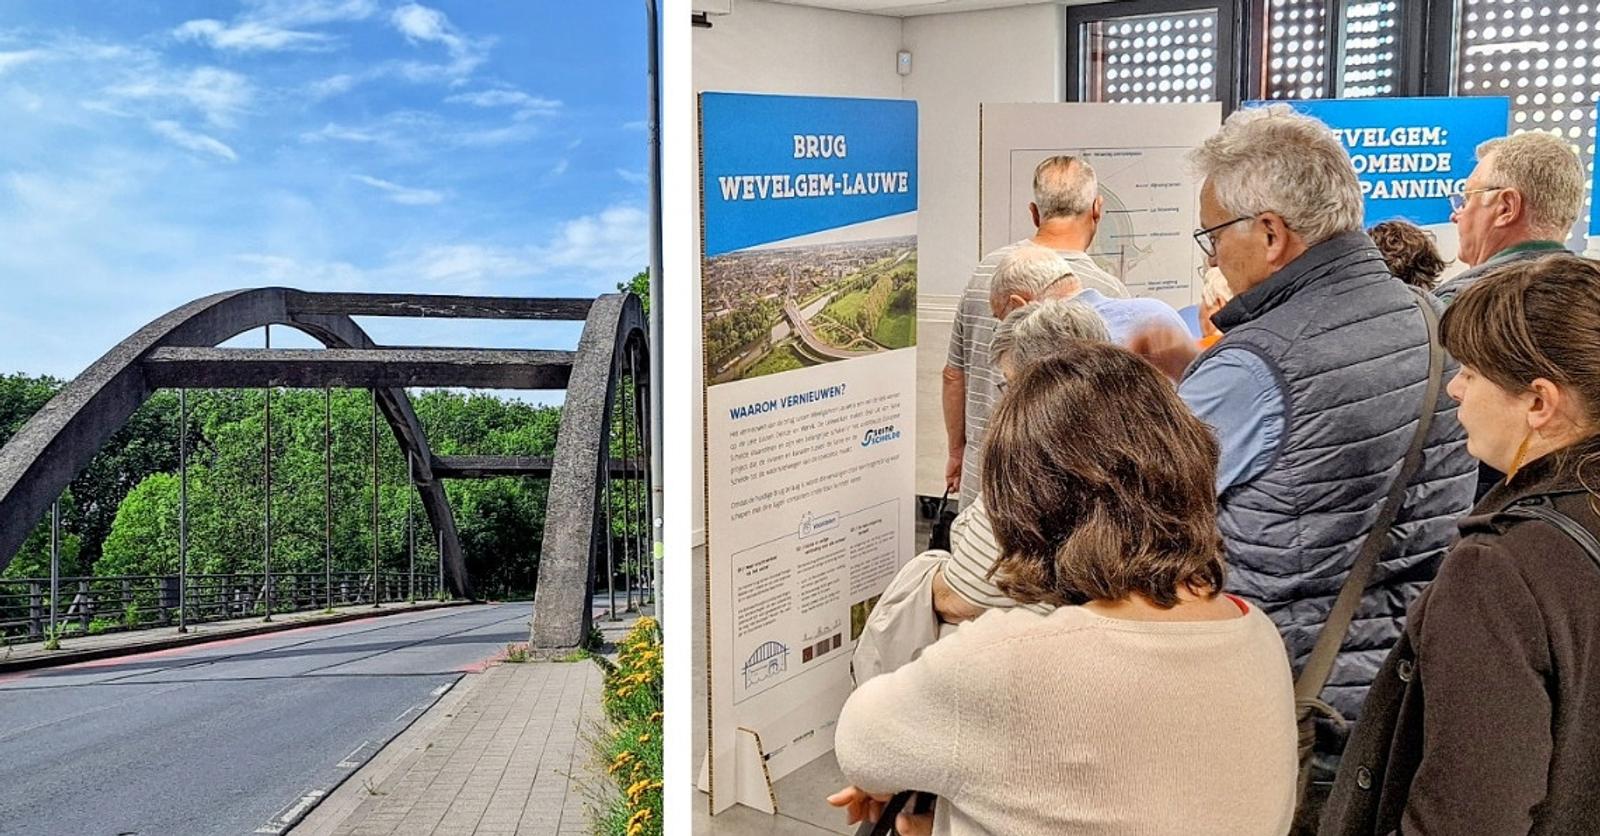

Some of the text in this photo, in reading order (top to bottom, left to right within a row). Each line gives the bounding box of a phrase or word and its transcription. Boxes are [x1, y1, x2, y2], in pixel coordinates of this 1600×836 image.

[793, 134, 847, 158] BRUG
[1351, 152, 1452, 174] OMENDE
[718, 171, 909, 201] WEVELGEM-LAUWE
[729, 399, 778, 420] WAAROM
[780, 383, 846, 409] VERNIEUWEN?
[871, 431, 901, 445] SCHELDE
